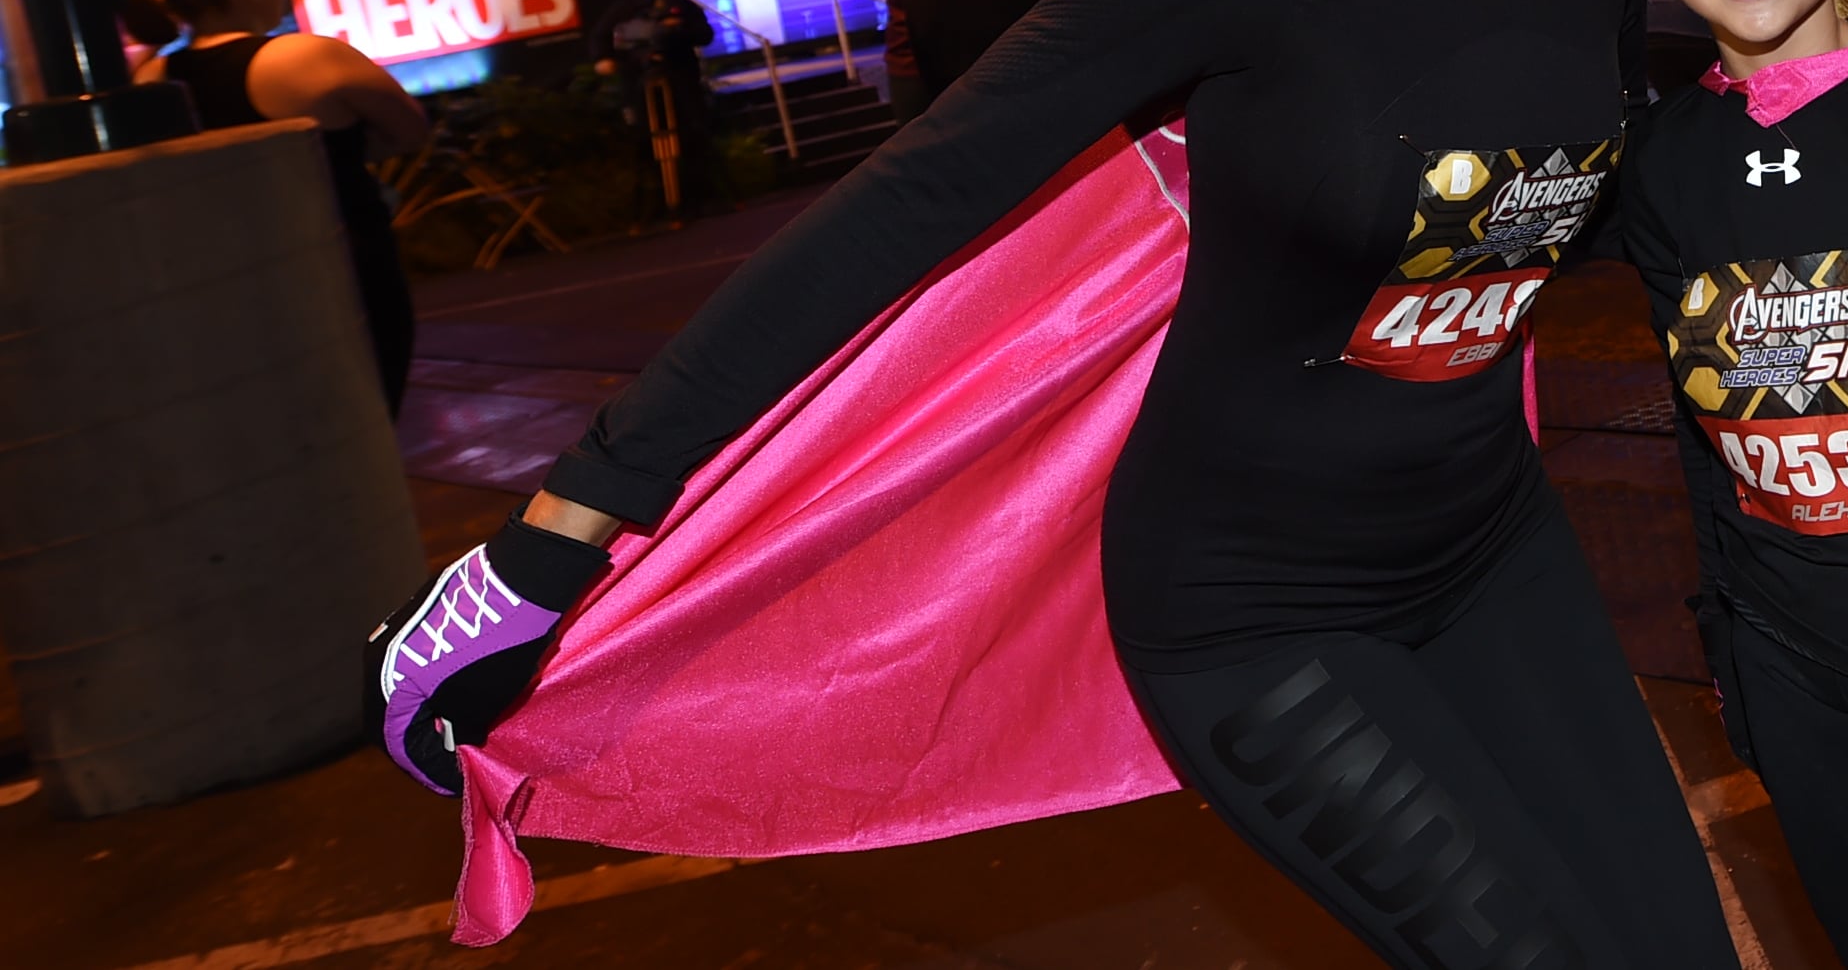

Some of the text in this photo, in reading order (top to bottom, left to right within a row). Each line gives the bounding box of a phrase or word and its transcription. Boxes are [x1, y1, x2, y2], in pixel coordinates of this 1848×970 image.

[1450, 159, 1474, 194] B
[1490, 171, 1607, 223] AVENGERS
[1484, 220, 1550, 242] SUPER
[1687, 277, 1705, 310] B
[1738, 346, 1805, 369] SUPER
[1719, 367, 1801, 389] HEROES
